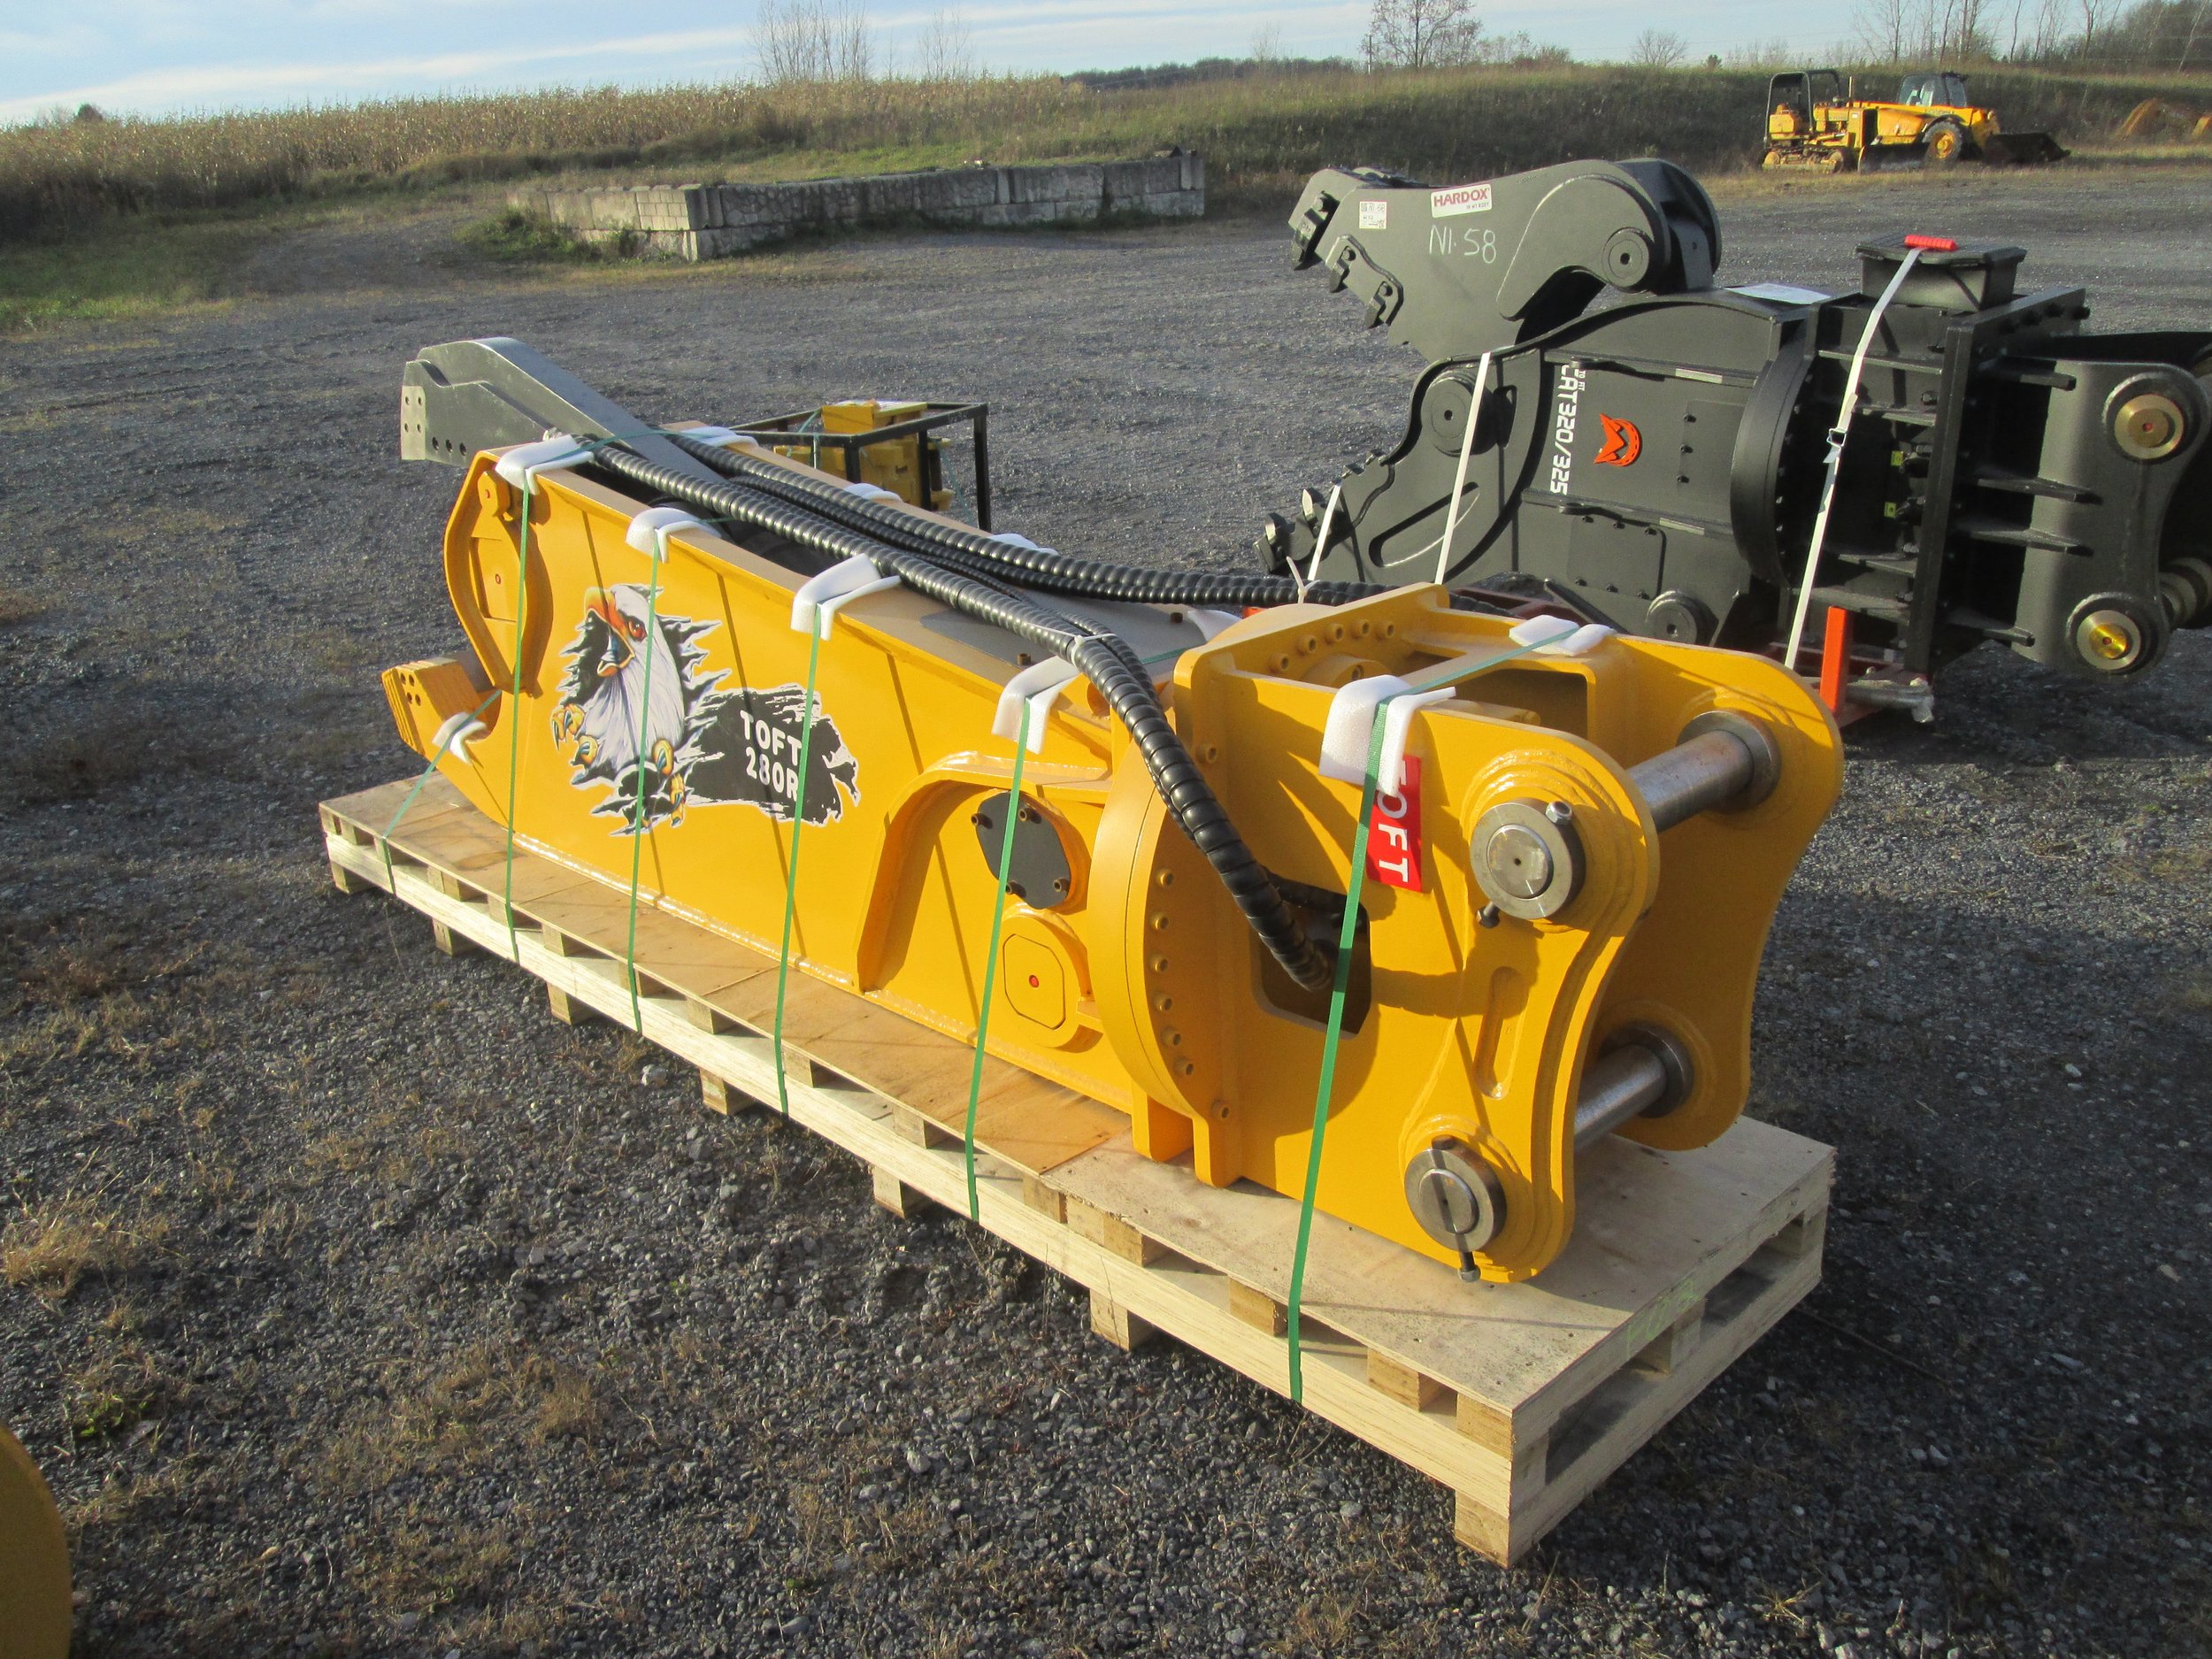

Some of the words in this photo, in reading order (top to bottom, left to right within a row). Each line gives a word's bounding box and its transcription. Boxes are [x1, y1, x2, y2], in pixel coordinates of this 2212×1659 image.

[1434, 188, 1488, 207] HARDOX
[740, 710, 803, 766] TOFT
[746, 746, 799, 802] 280R
